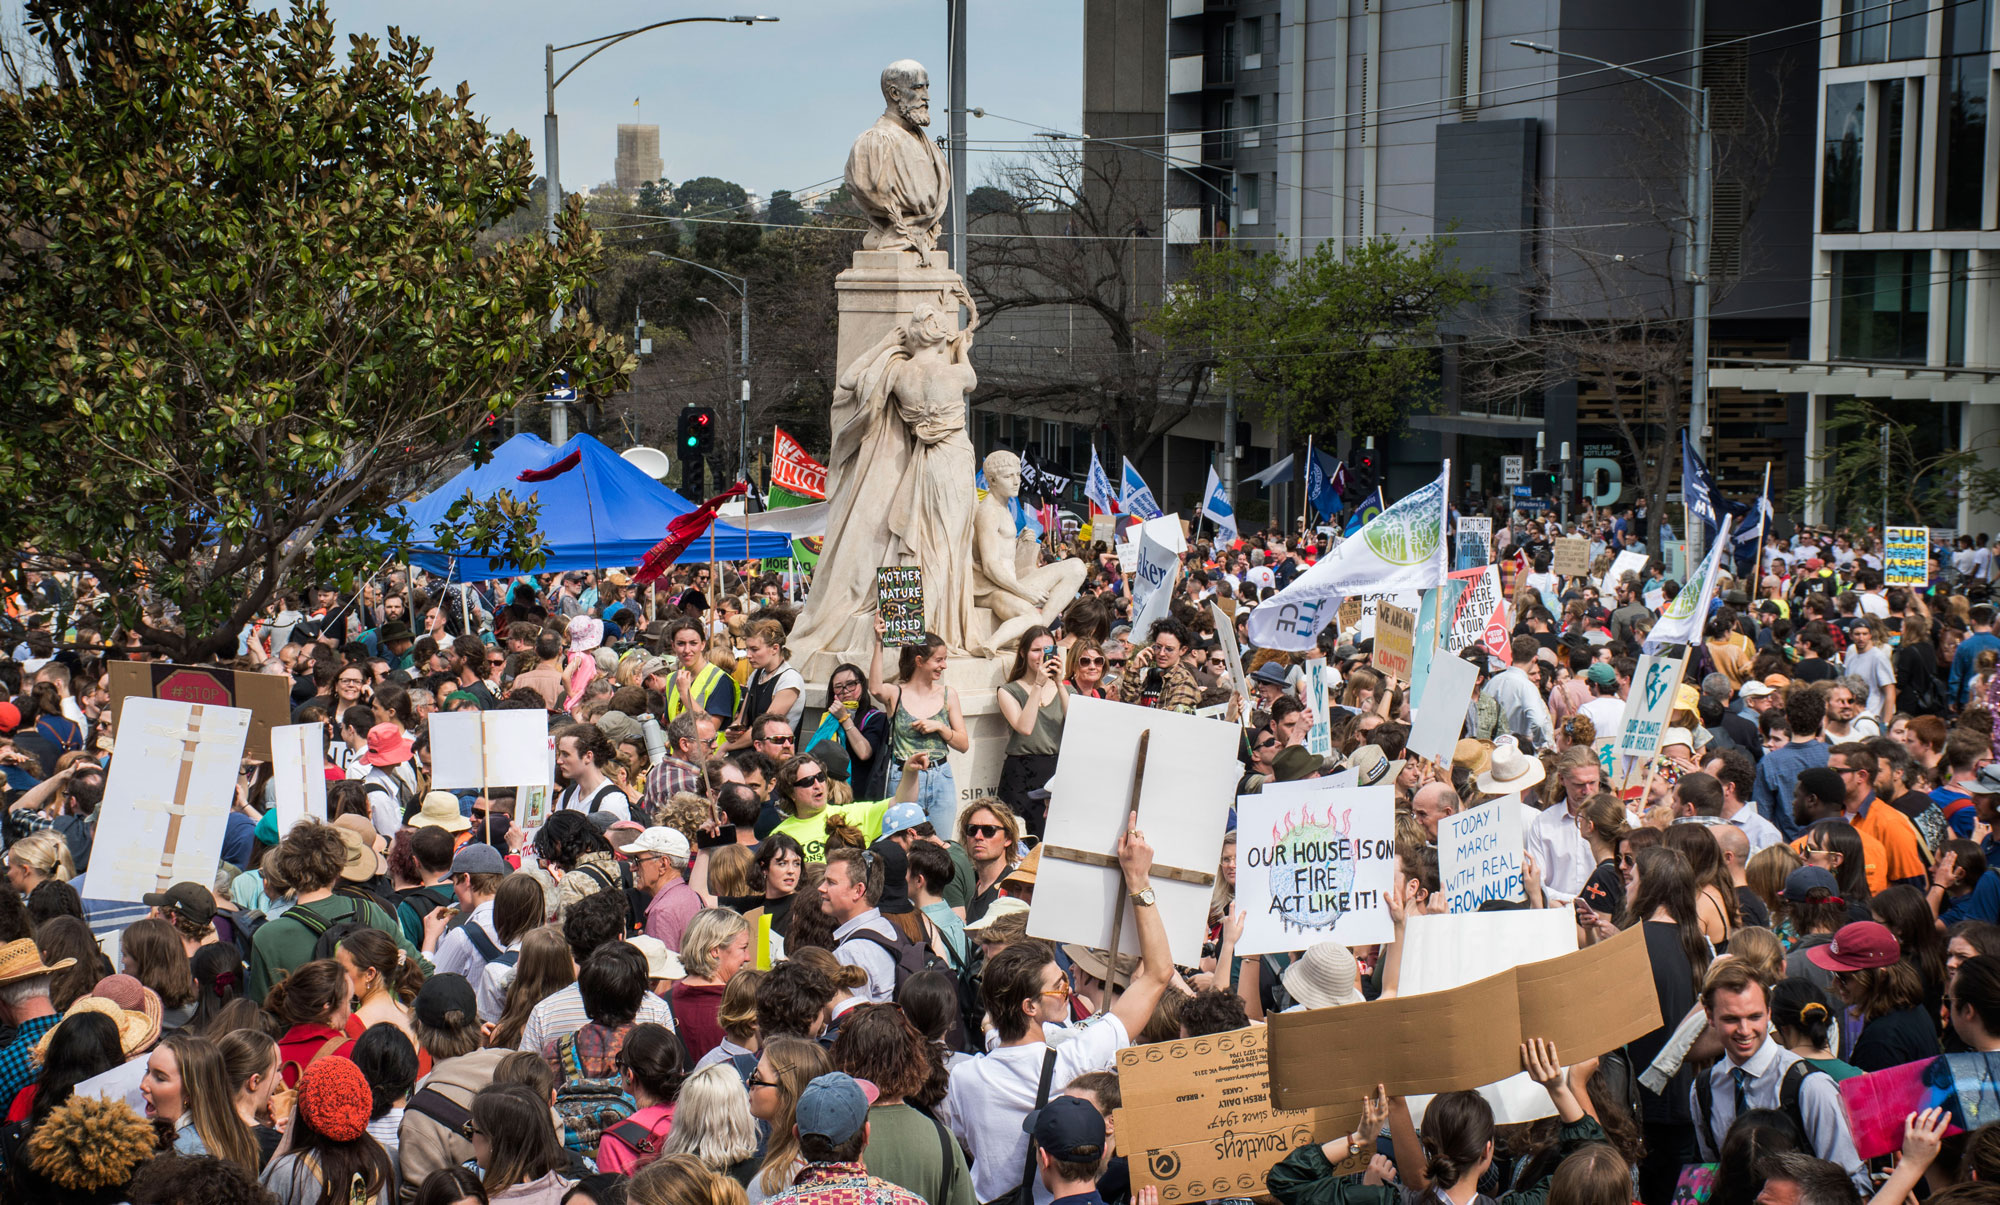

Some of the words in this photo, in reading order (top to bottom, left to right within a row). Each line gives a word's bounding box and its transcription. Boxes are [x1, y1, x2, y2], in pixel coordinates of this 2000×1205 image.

[778, 436, 805, 463] WE
[1583, 458, 1622, 506] D
[1887, 550, 1926, 560] DESERVE
[1887, 559, 1898, 570] A
[1900, 559, 1926, 570] SAFE
[878, 570, 921, 583] MOTHER
[1887, 572, 1926, 583] FUTURE
[880, 587, 921, 600] NATURE
[898, 605, 906, 614] IS
[1456, 604, 1478, 620] TAKE
[1479, 600, 1494, 616] OFF
[886, 620, 921, 632] PISSED
[1380, 604, 1390, 624] WE
[1390, 612, 1402, 629] ARE
[1404, 616, 1413, 634] ON
[1460, 618, 1484, 635] YOUR
[171, 685, 219, 700] #STOP
[1626, 718, 1639, 732] OUR
[1639, 720, 1662, 736] CLIMATE
[1622, 734, 1636, 748] OUR
[1635, 736, 1656, 752] HEALTH
[962, 788, 983, 800] SIR
[1452, 810, 1490, 838] TODAY
[1248, 844, 1287, 868] OUR
[1294, 838, 1352, 864] HOUSE
[1357, 838, 1374, 860] IS
[1376, 840, 1394, 860] ON
[1456, 832, 1497, 863] MARCH
[1446, 866, 1475, 892] WITH
[1482, 852, 1520, 878] REAL
[1294, 866, 1338, 894] FIRE
[1268, 895, 1304, 914] ACT
[1308, 892, 1350, 914] LIKE
[1355, 890, 1378, 910] IT!
[1218, 1064, 1239, 1072] Geelong
[1239, 1062, 1254, 1071] North
[1176, 1094, 1198, 1102] BREAD
[1222, 1086, 1244, 1096] CAKES
[1218, 1098, 1242, 1109] DAILY
[1242, 1094, 1266, 1106] FRESH
[1242, 1110, 1268, 1124] since
[1214, 1130, 1288, 1162] Routleys
